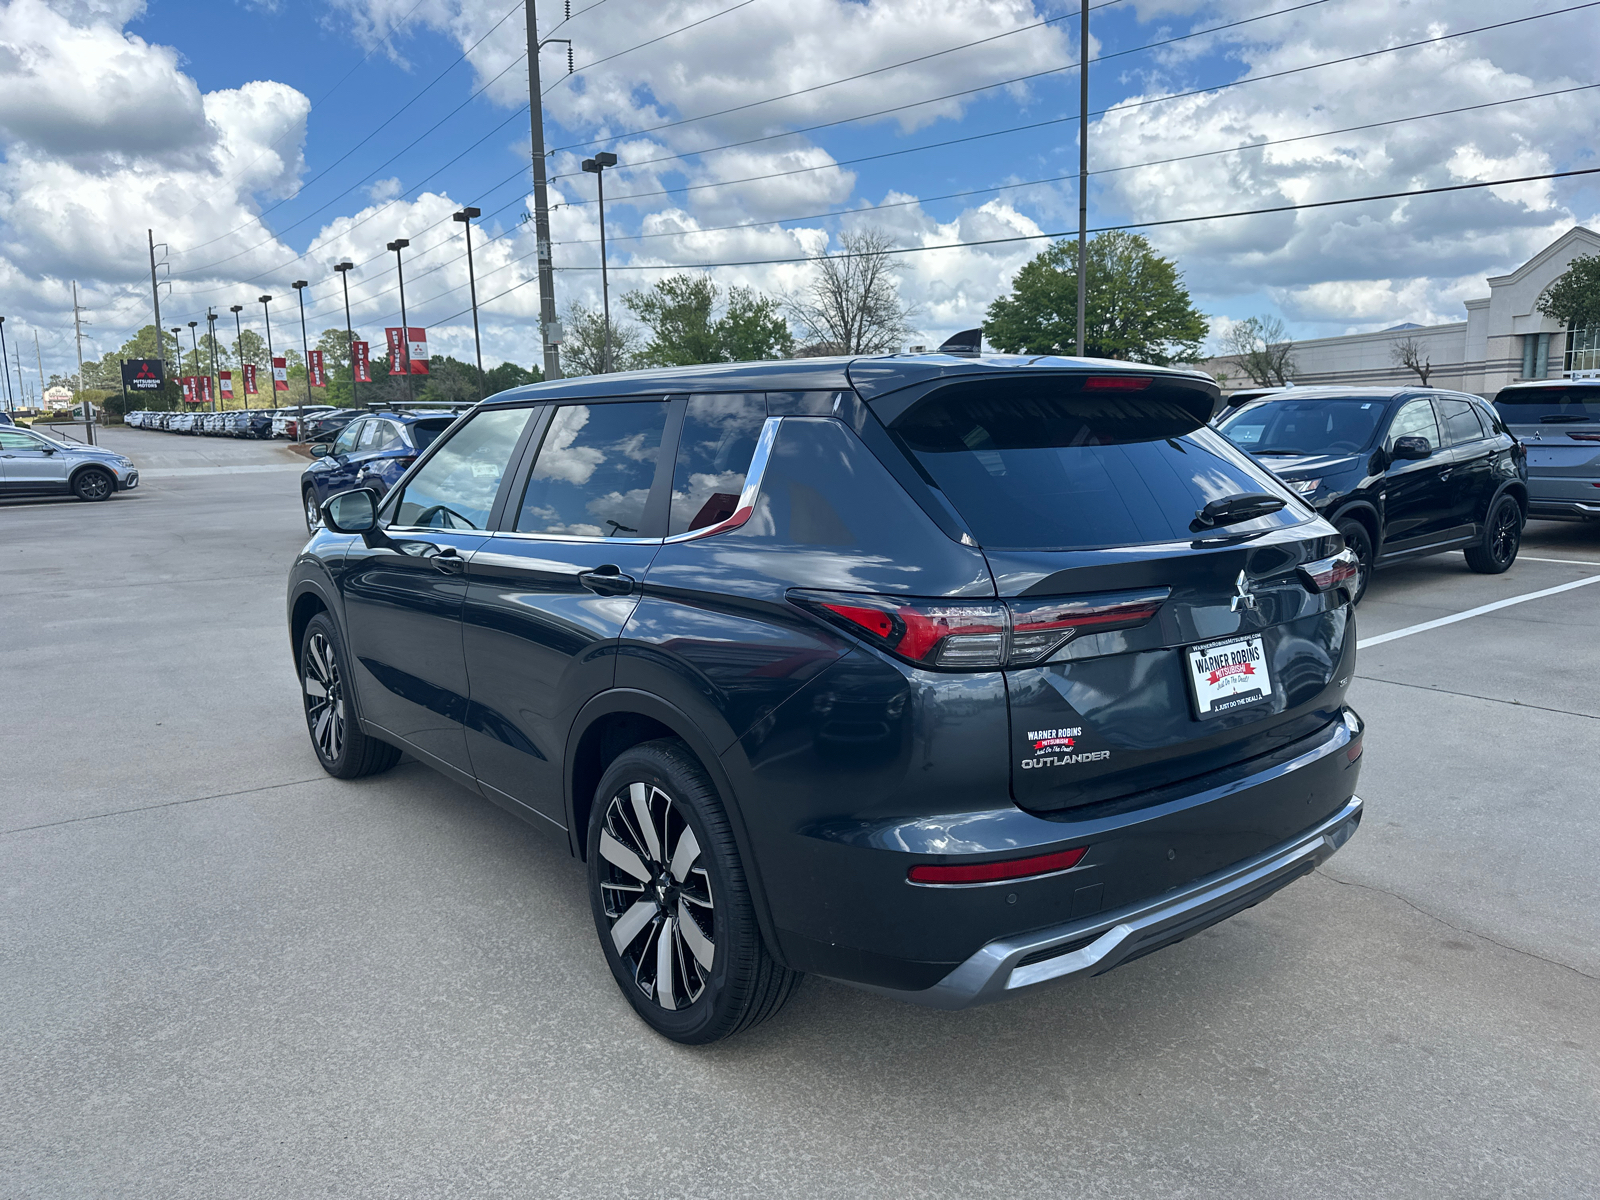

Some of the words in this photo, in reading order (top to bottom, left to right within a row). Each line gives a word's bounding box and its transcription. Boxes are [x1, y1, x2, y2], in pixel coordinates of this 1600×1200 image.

[392, 330, 400, 372] PRE-OWNED
[1195, 653, 1230, 674] WARNER
[1230, 646, 1260, 666] ROBINS
[1216, 664, 1246, 678] MITSUBISHI
[1219, 702, 1230, 710] JUST
[1246, 696, 1258, 704] DEAL!
[1028, 730, 1056, 740] WARNER
[1058, 726, 1082, 738] ROBINS
[1021, 750, 1110, 770] OUTLANDER
